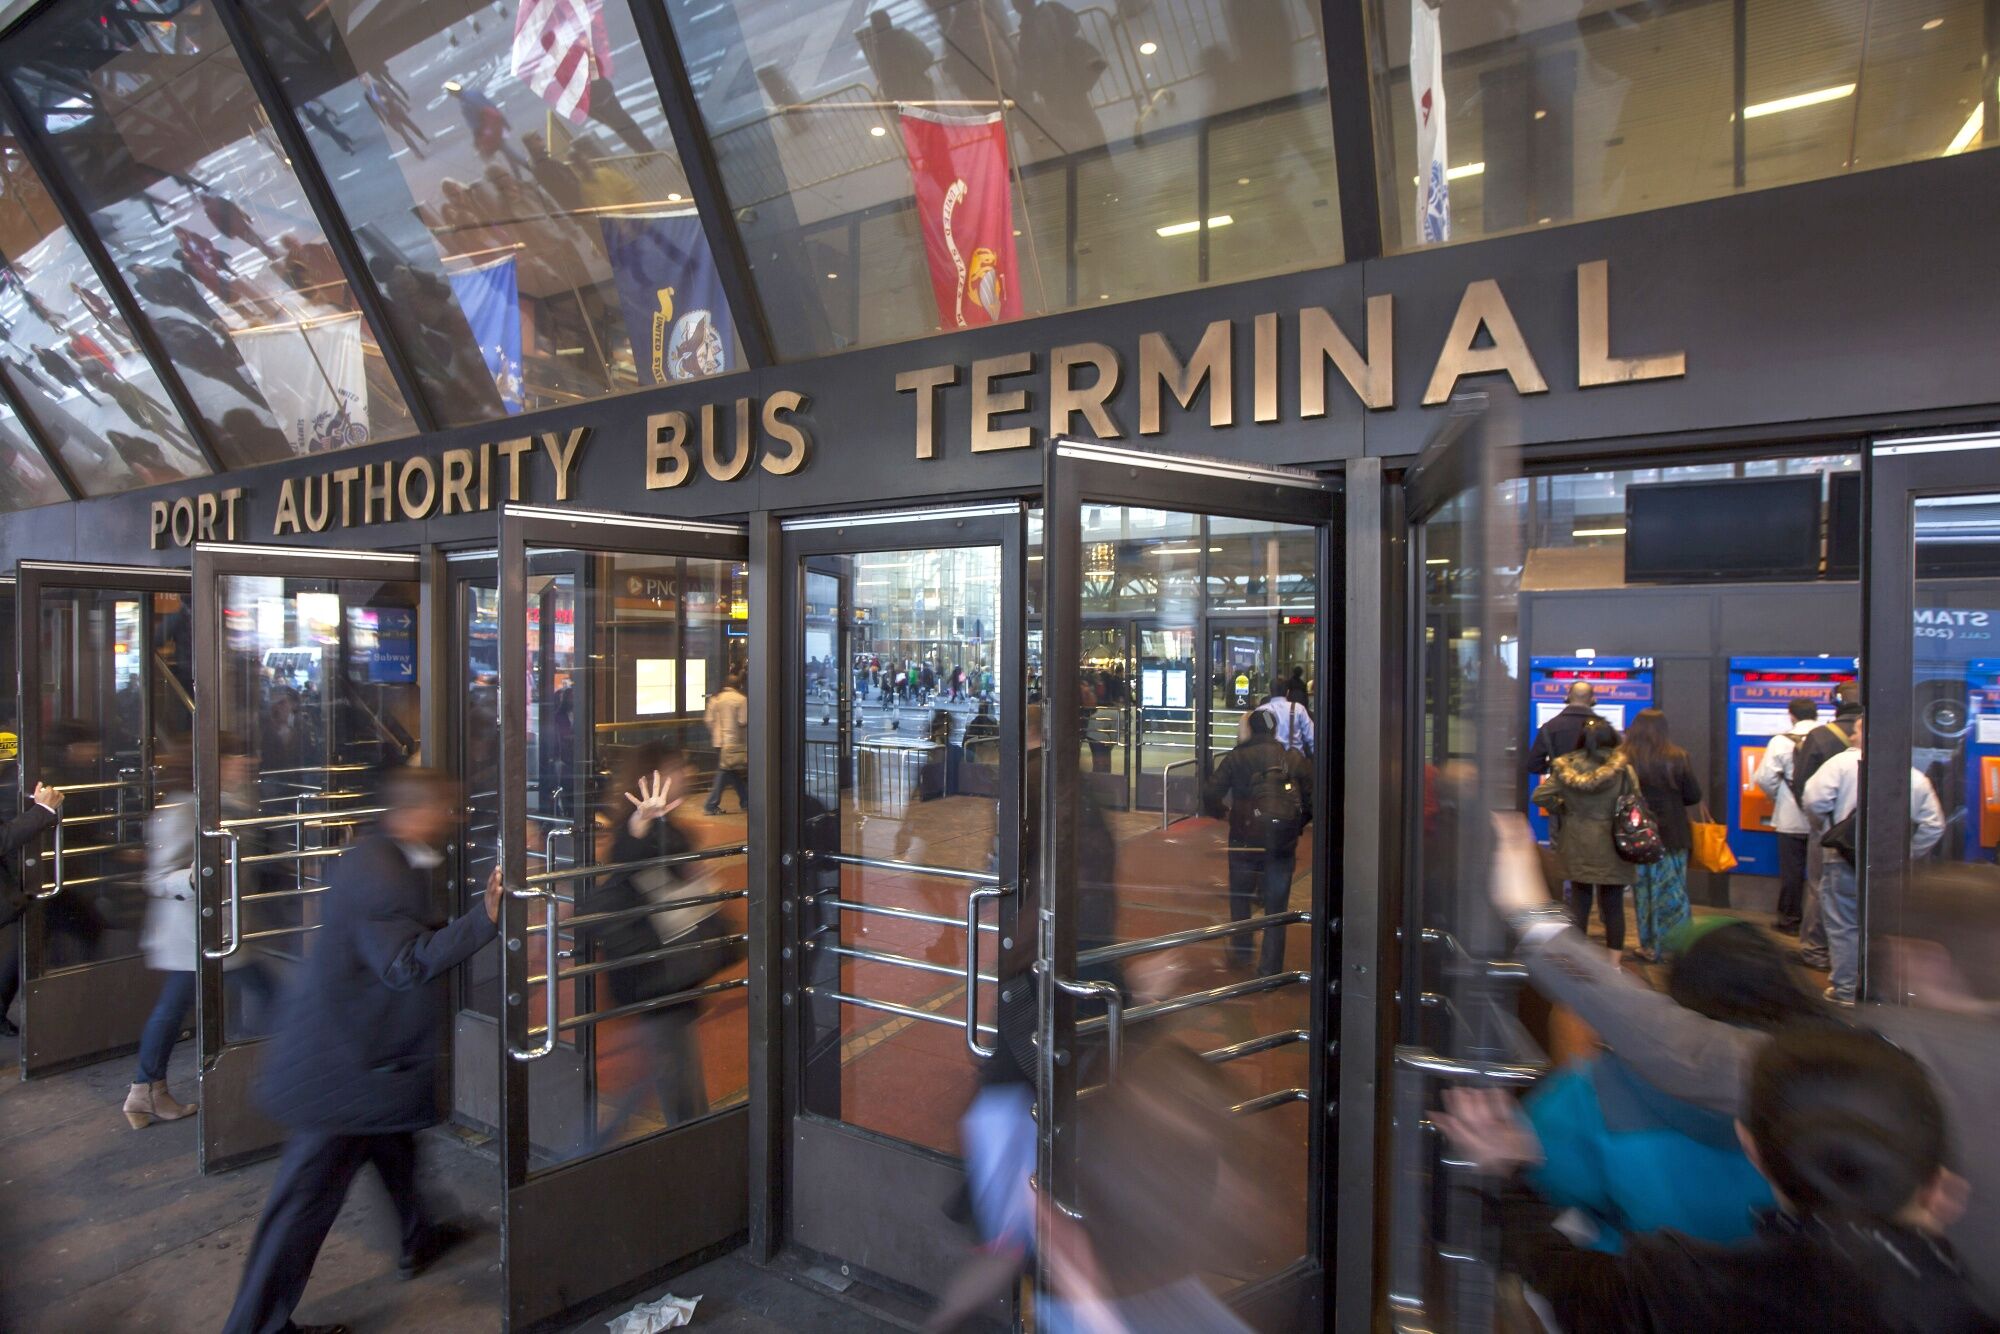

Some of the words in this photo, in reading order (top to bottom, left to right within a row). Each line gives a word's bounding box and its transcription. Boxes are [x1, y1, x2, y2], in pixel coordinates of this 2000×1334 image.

[655, 316, 664, 351] UNITED
[151, 487, 244, 550] PORT
[273, 426, 591, 535] AUTHORITY
[645, 390, 810, 490] BUS
[896, 260, 1686, 459] TERMINAL
[647, 579, 676, 596] PNC
[374, 652, 410, 662] Subway
[1633, 657, 1654, 668] 913
[1746, 687, 1763, 697] NJ
